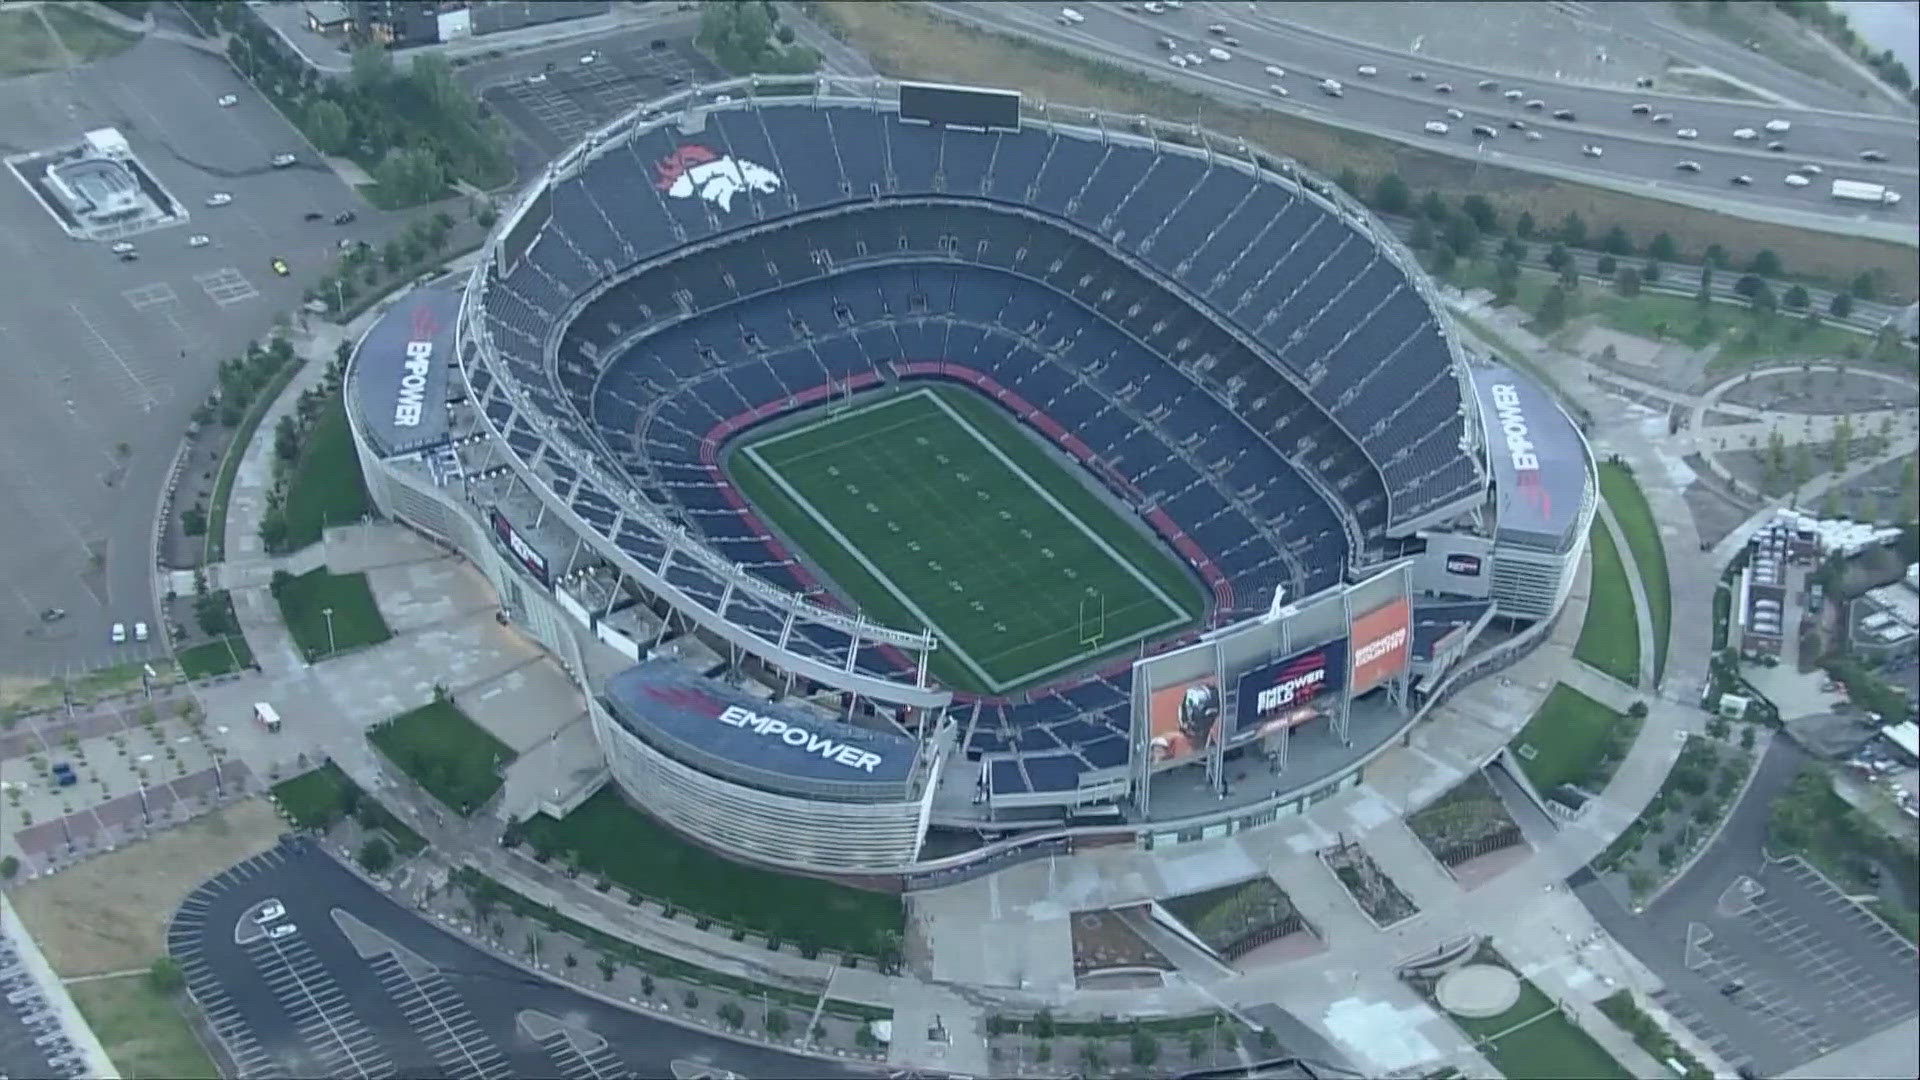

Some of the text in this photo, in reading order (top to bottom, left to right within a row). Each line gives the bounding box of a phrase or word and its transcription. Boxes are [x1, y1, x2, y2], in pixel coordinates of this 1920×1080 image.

[394, 341, 433, 427] EMPOWER
[1491, 383, 1540, 471] EMPOWER
[1258, 669, 1324, 703] EMPOWER
[718, 704, 882, 774] EMPOWER
